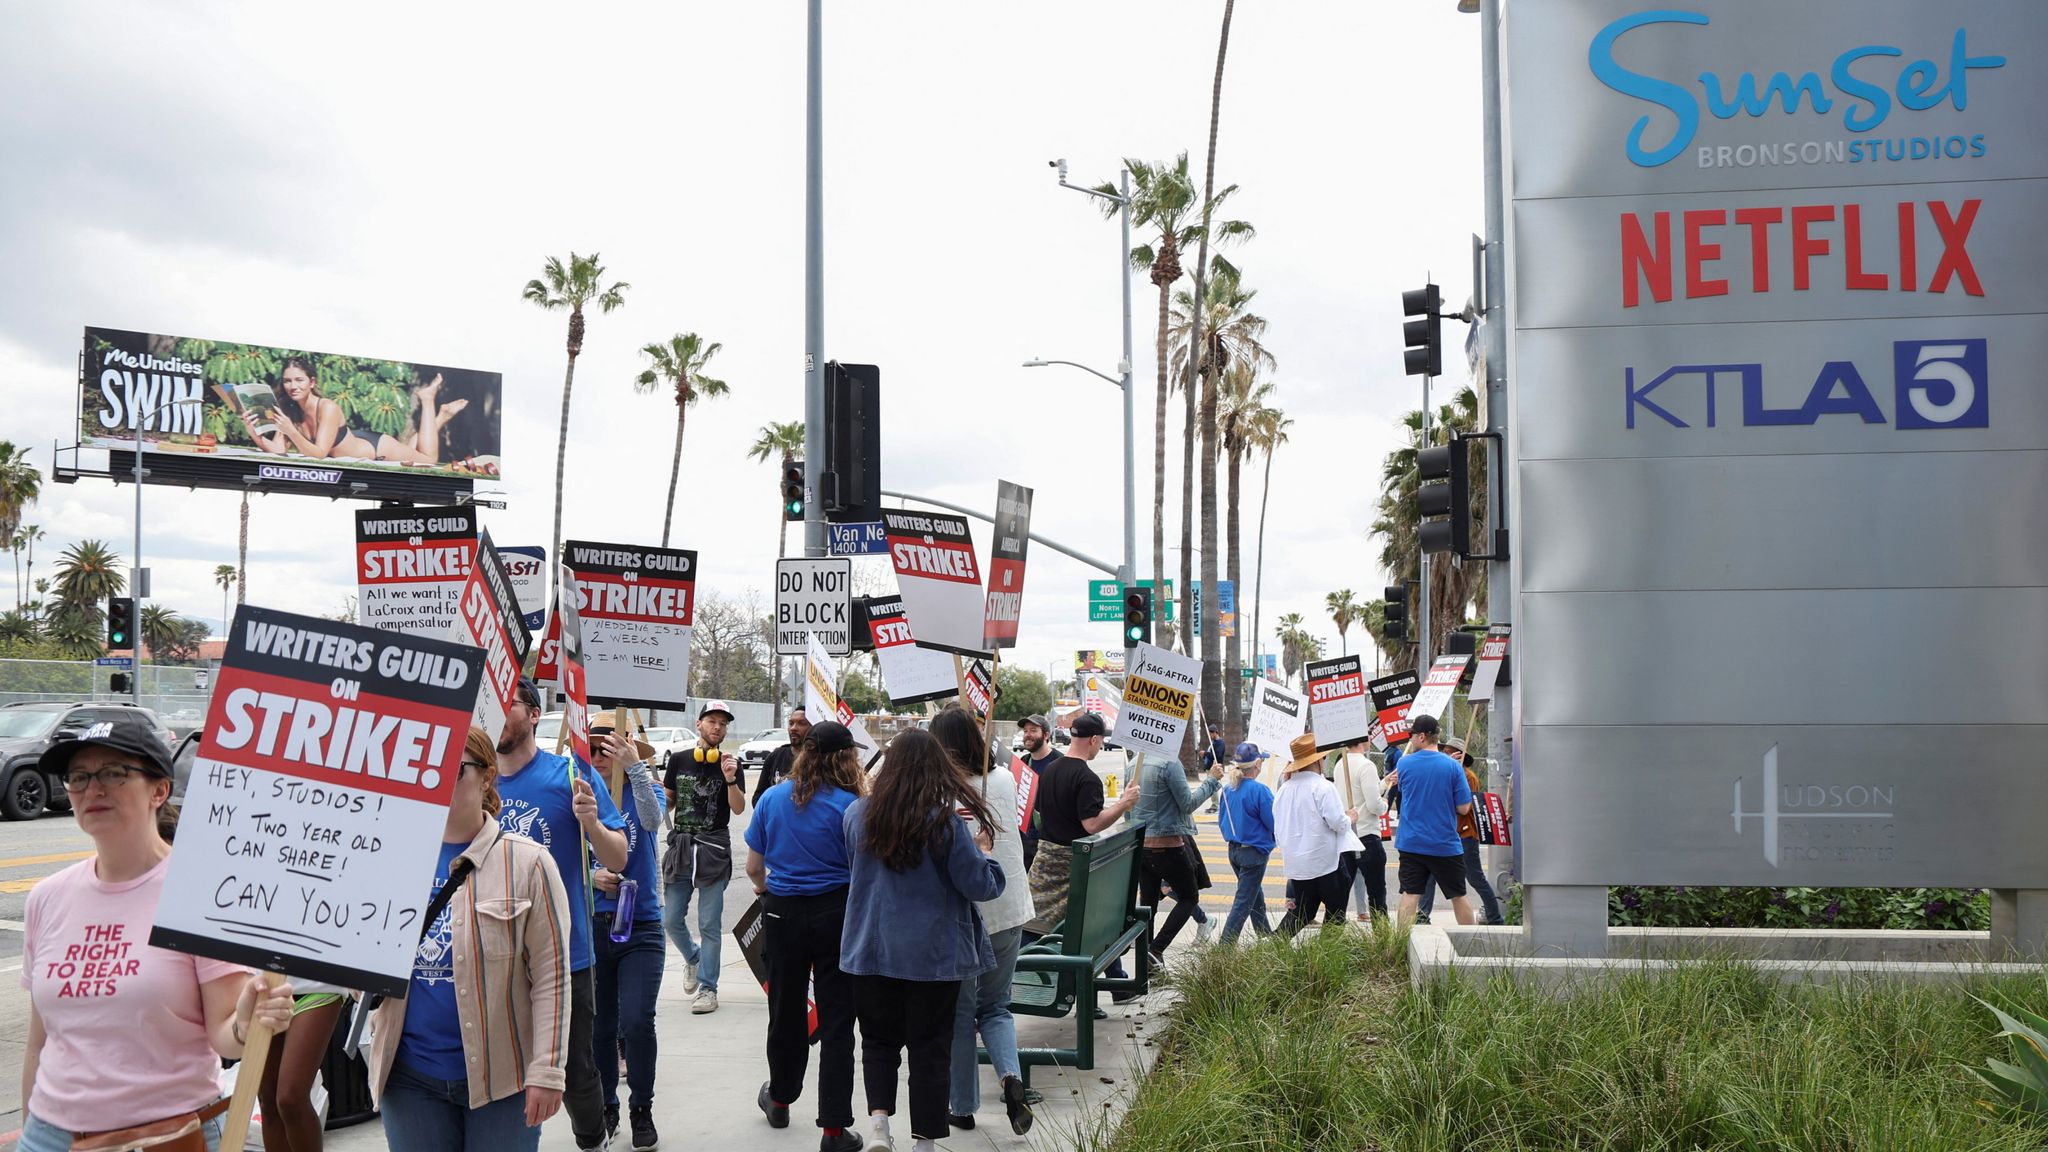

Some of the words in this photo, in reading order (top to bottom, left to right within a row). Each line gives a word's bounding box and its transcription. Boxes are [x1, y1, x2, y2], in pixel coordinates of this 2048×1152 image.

[1620, 199, 1985, 308] NETFLIX
[104, 349, 203, 375] MeUndies
[1625, 361, 1888, 430] KTLA
[1908, 344, 1975, 423] 5
[99, 369, 203, 435] SWIM
[262, 467, 337, 482] OUTFRONT
[490, 501, 504, 509] 1102
[363, 518, 425, 535] WRITERS
[427, 517, 468, 533] GUILD
[833, 525, 859, 542] Van
[866, 524, 887, 541] Ne
[886, 514, 933, 532] WRITERS
[933, 519, 965, 536] GUILD
[409, 536, 423, 546] ON
[833, 541, 857, 553] 1400
[861, 541, 868, 552] N
[923, 535, 935, 545] ON
[363, 545, 470, 579] STRIKE!
[505, 561, 540, 576] ASH
[573, 547, 642, 568] WRITERS
[644, 553, 690, 572] GUILD
[893, 543, 975, 579] STRIKE!
[623, 571, 638, 582] ON
[780, 571, 803, 592] DO
[813, 571, 846, 592] NOT
[1003, 569, 1013, 587] ON
[366, 588, 386, 600] All
[391, 591, 407, 599] we
[412, 585, 441, 600] want
[447, 589, 458, 600] is
[1102, 585, 1116, 594] 101
[367, 603, 414, 616] LaCroix
[419, 601, 442, 615] and
[445, 602, 457, 614] fa
[482, 545, 511, 618] WRITERS
[507, 610, 526, 655] GUILD
[575, 580, 687, 619] STRIKE!
[986, 592, 1021, 622] STRIKE!
[780, 602, 846, 624] BLOCK
[594, 620, 649, 632] WEDDING
[655, 625, 670, 634] IS
[674, 628, 687, 636] IN
[780, 630, 846, 645] INTERCTION
[466, 581, 516, 703] STRIKE!
[591, 631, 604, 643] 2
[610, 634, 660, 646] WEEKS
[245, 620, 374, 673] WRITERS
[377, 645, 468, 690] GUILD
[613, 654, 629, 662] AM
[633, 654, 670, 671] HERE!
[1310, 664, 1339, 677] WRITERS
[1339, 661, 1357, 672] GUILD
[330, 676, 360, 702] ON
[1130, 678, 1189, 708] UNIONS
[1312, 676, 1360, 701] STRIKE!
[1372, 680, 1399, 694] WRITERS
[1398, 676, 1416, 686] GUILD
[1127, 693, 1149, 706] STAND
[1149, 701, 1186, 718] TOGETHER
[1265, 692, 1297, 711] WGAW
[1386, 693, 1413, 706] AMERICA
[1128, 711, 1176, 733] WRITERS
[1384, 719, 1413, 736] STR
[215, 688, 451, 791] STRIKE!
[1131, 728, 1164, 745] GUILD
[208, 763, 256, 799] HEY,
[501, 798, 514, 808] LD
[515, 799, 529, 809] OF
[208, 802, 237, 827] MY
[301, 821, 340, 846] YEAR
[351, 833, 382, 854] OLD
[626, 819, 637, 853] AMERIC
[225, 836, 265, 858] CAN
[277, 845, 348, 878] SHARE!
[214, 874, 278, 912] CAN
[84, 924, 125, 942] THE
[64, 942, 132, 961] RIGHT
[46, 962, 76, 979] TO
[81, 959, 140, 979] BEAR
[57, 979, 117, 998] ARTS
